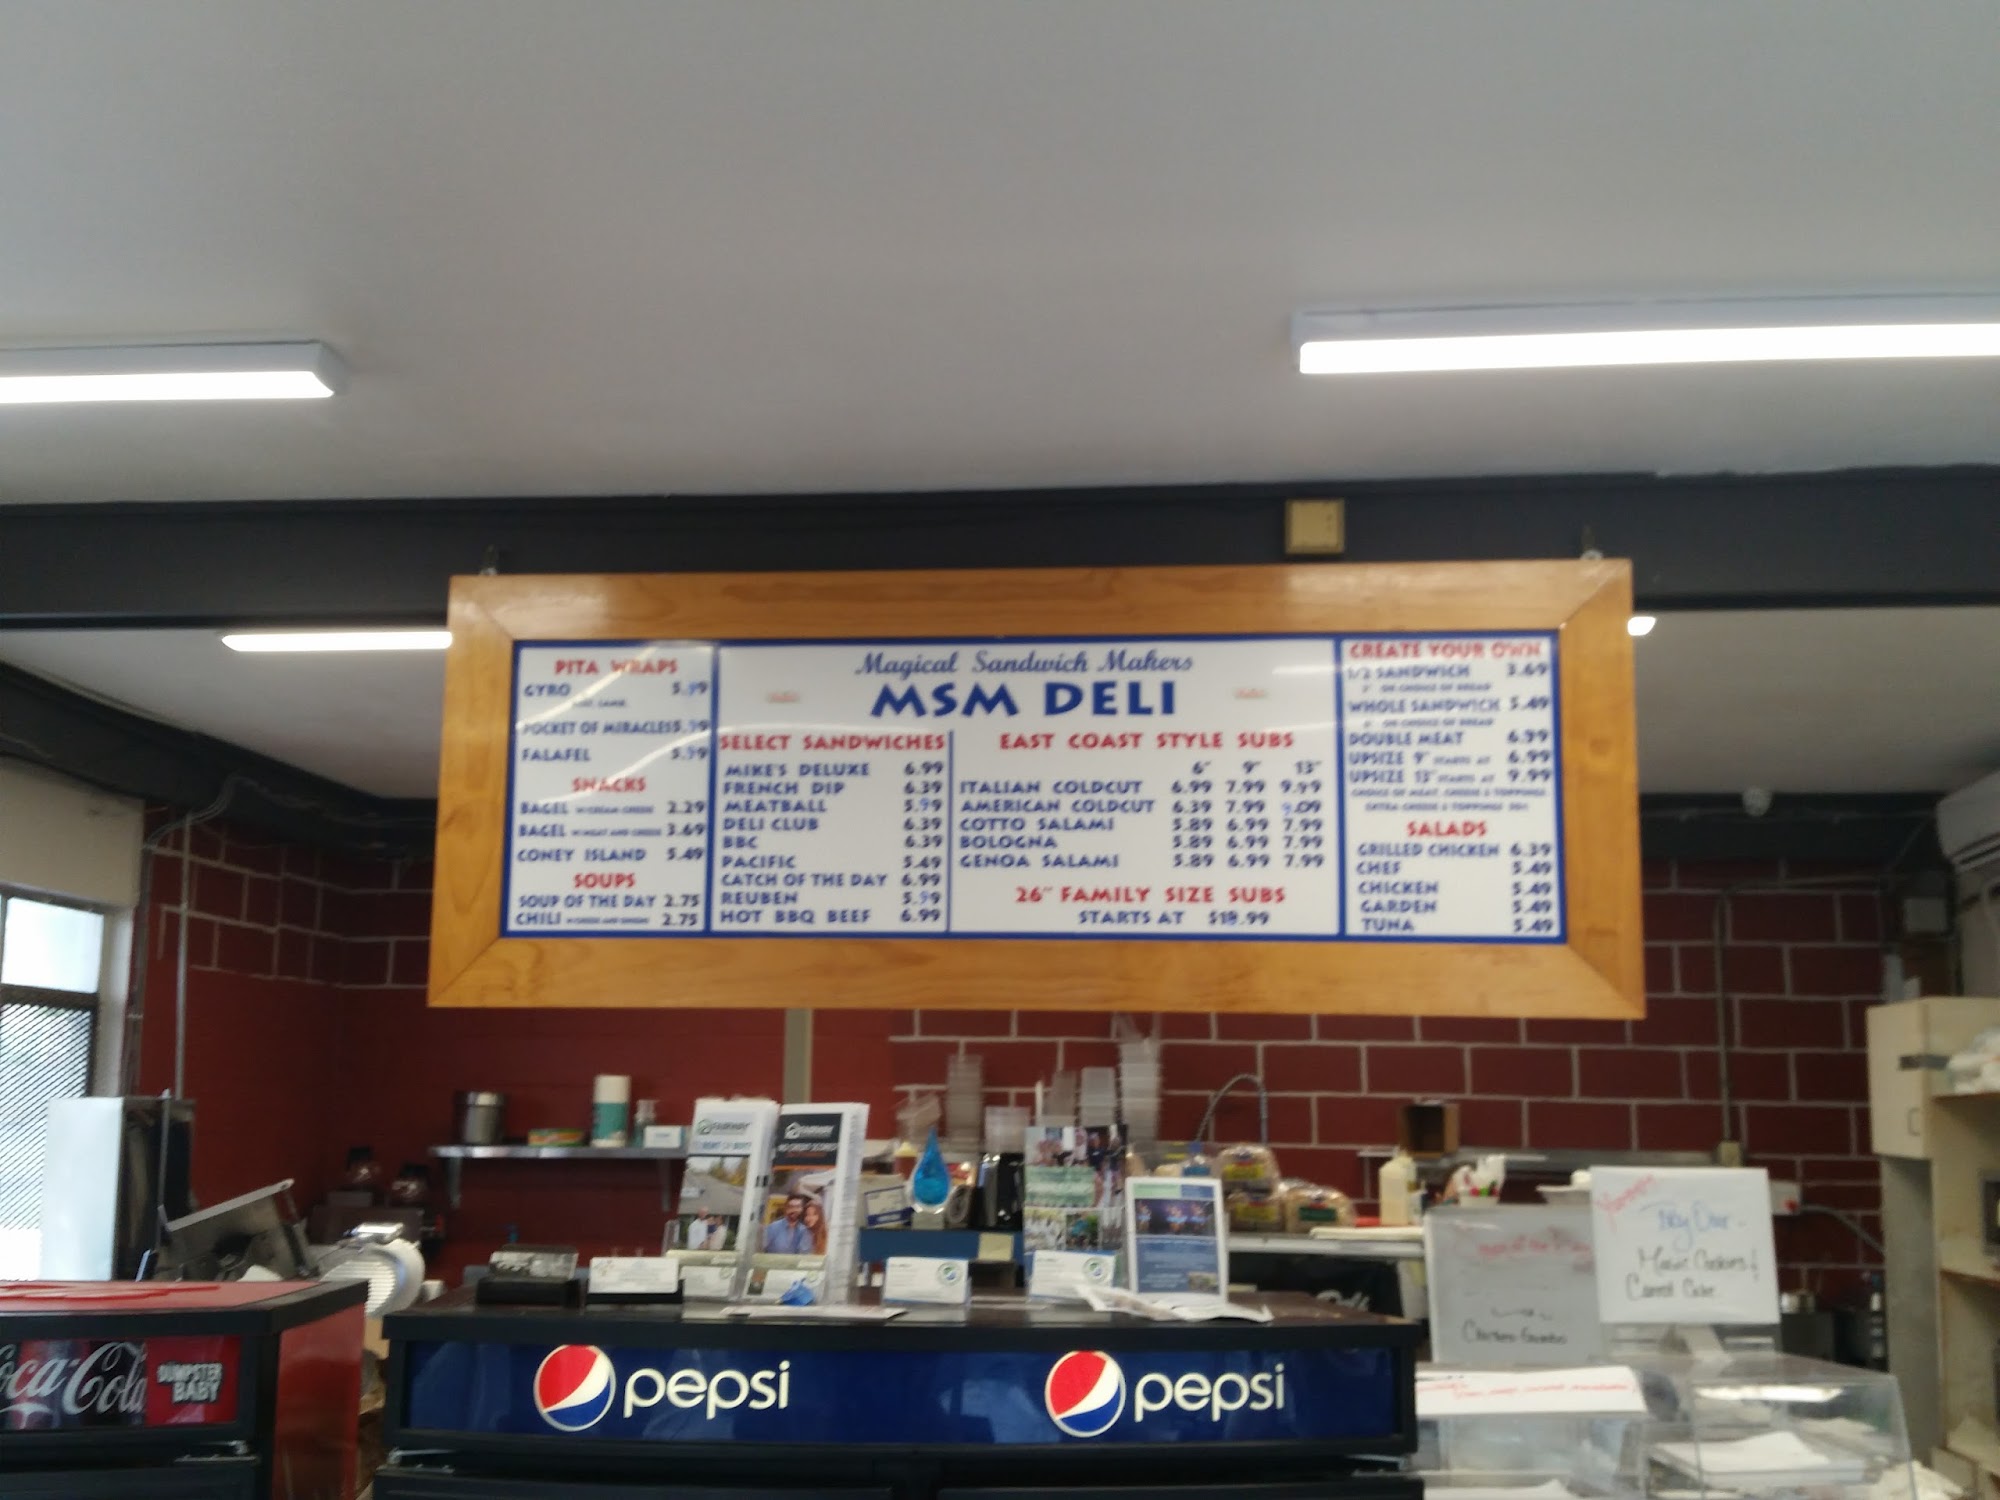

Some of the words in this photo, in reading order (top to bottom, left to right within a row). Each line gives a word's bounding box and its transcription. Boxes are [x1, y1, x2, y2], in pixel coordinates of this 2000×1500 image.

[1350, 643, 1420, 658] CREATE
[1429, 643, 1485, 658] YOUR
[1492, 642, 1540, 657] OWN
[554, 659, 600, 675] PITA
[610, 658, 679, 675] WRAPS
[855, 650, 960, 681] Magical
[972, 650, 1089, 674] Sandwich
[1098, 649, 1193, 673] Makers
[1376, 664, 1470, 678] SANDWICH
[524, 683, 572, 697] GYRO
[870, 682, 1020, 719] MSM
[1044, 680, 1177, 717] DELI
[1349, 699, 1405, 712] WHOLE
[1411, 698, 1500, 712] SANDWICH
[523, 722, 576, 735] POCKET
[580, 721, 597, 735] OF
[720, 734, 791, 751] SELECT
[803, 734, 946, 750] SANDWICHES
[999, 733, 1054, 750] EAST
[1068, 733, 1143, 750] COAST
[1157, 732, 1224, 749] STYLE
[1238, 732, 1295, 749] SUBS
[1349, 732, 1412, 746] DOUBLE
[1418, 731, 1464, 745] MEAT
[522, 748, 591, 762] FALAFEL
[1349, 751, 1404, 765] UPSIZE
[725, 762, 788, 777] MIKE'S
[799, 762, 870, 776] DELUXE
[904, 761, 944, 775] 6.99
[1349, 770, 1404, 784] UPSIZE
[572, 777, 647, 793] SNACKS
[724, 781, 799, 795] FRENCH
[811, 781, 846, 795] DIP
[904, 781, 944, 794] 6.39
[960, 780, 1042, 794] ITALIAN
[1053, 780, 1143, 794] COLDCUT
[1171, 780, 1213, 795] 6.99
[1225, 780, 1266, 795] 7.99
[520, 801, 569, 815] BAGEL
[667, 800, 706, 815] 2.29
[724, 799, 827, 813] MEATBALL
[960, 799, 1061, 813] AMERICAN
[1071, 799, 1157, 813] COLDCUT
[1171, 799, 1213, 814] 6.39
[1225, 799, 1266, 814] 7.99
[518, 824, 566, 838] BAGEL
[723, 817, 765, 831] DELI
[771, 817, 819, 831] CLUB
[904, 817, 943, 831] 6.39
[959, 818, 1027, 832] COTTO
[1038, 818, 1115, 832] SALAMI
[1226, 817, 1270, 832] 6.99
[1283, 817, 1325, 832] 7.99
[1407, 820, 1488, 837] SALADS
[904, 835, 943, 849] 6.39
[959, 836, 1058, 850] BOLOGNA
[1226, 835, 1270, 850] 6.99
[1283, 835, 1325, 850] 7.99
[518, 848, 575, 862] CONEY
[584, 848, 647, 862] ISLAND
[1357, 843, 1423, 858] GRILLED
[1428, 843, 1500, 857] CHICKEN
[722, 855, 797, 869] PACIFIC
[959, 854, 1031, 869] GENOA
[1042, 854, 1120, 869] SALAMI
[1227, 854, 1271, 868] 6.99
[1284, 854, 1326, 868] 7.99
[1356, 861, 1402, 875] CHEF
[572, 872, 636, 889] SOUPS
[721, 873, 778, 887] CATCH
[783, 873, 807, 887] OF
[811, 873, 845, 887] THE
[850, 873, 888, 887] DAY
[901, 873, 941, 887] 6.99
[1060, 887, 1151, 903] FAMILY
[1165, 887, 1214, 903] SIZE
[1229, 887, 1287, 903] SUBS
[1358, 881, 1439, 895] CHICKEN
[518, 894, 560, 908] SOUP
[564, 894, 584, 908] OF
[589, 894, 619, 908] THE
[623, 894, 656, 908] DAY
[663, 894, 700, 908] 2.75
[721, 891, 799, 905] REUBEN
[1360, 899, 1438, 914] GARDEN
[516, 912, 562, 926] CHILI
[662, 913, 698, 927] 2.75
[720, 909, 762, 924] HOT
[775, 909, 815, 925] BBQ
[827, 909, 872, 923] BEEF
[900, 909, 941, 923] 6.99
[1078, 910, 1151, 925] STARTS
[1158, 910, 1186, 925] AT
[1361, 917, 1415, 932] TUNA
[172, 1381, 220, 1404] BABY
[623, 1360, 791, 1421] pepsi
[1134, 1363, 1285, 1423] pepsi
